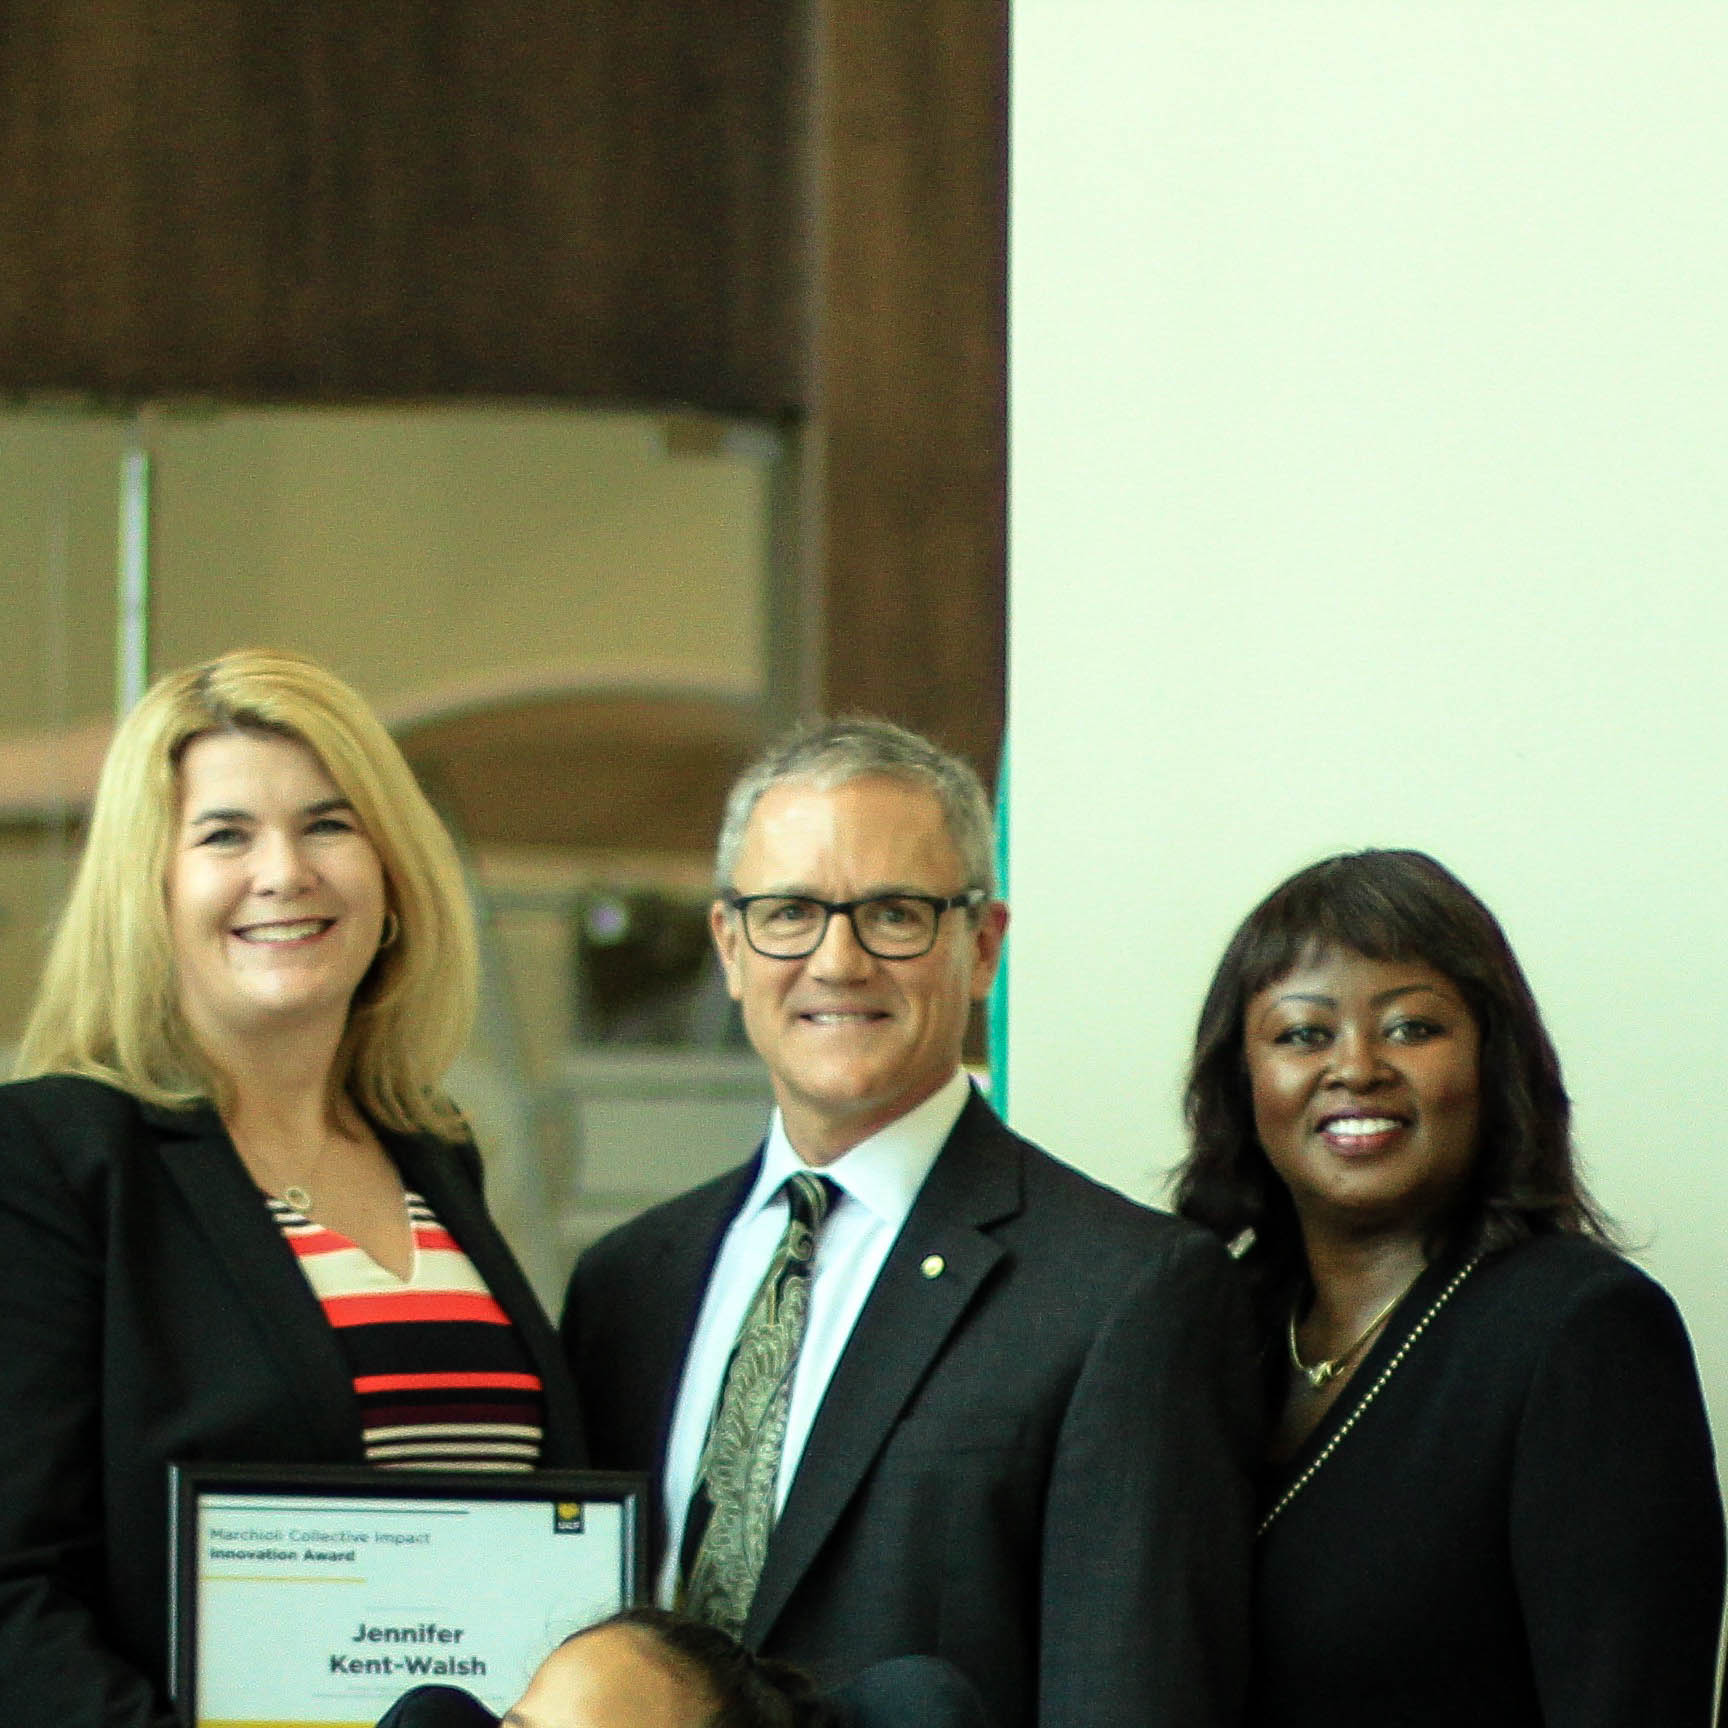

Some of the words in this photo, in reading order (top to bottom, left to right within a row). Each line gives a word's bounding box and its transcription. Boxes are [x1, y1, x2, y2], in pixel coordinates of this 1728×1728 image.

[288, 1530, 369, 1543] Collective
[375, 1532, 431, 1545] Impact
[210, 1548, 297, 1560] Innovation
[304, 1550, 355, 1561] Award
[352, 1623, 464, 1643] Jennifer
[329, 1654, 486, 1675] Kent-Walsh
